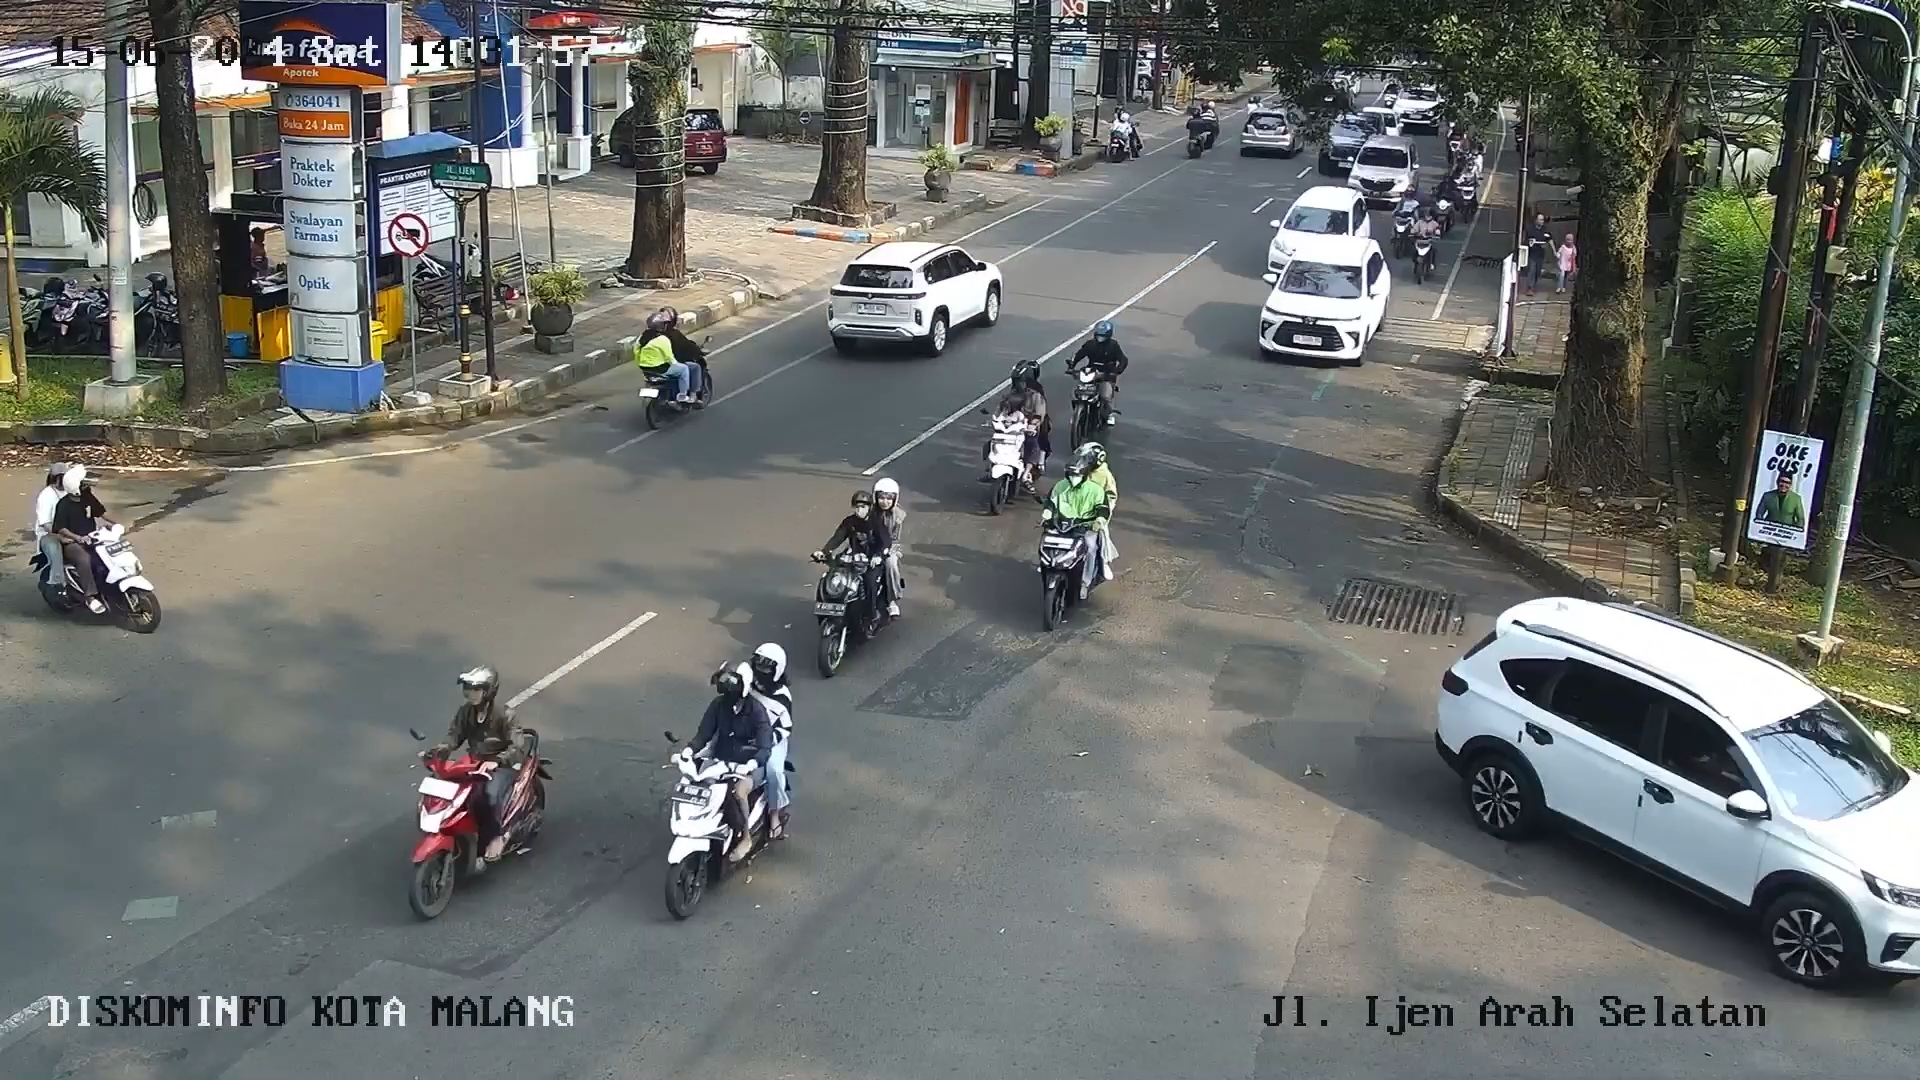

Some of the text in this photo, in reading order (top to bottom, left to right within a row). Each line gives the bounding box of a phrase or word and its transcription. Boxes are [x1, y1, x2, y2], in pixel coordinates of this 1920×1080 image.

[282, 67, 320, 79] Apotek
[295, 95, 341, 108] 364041
[283, 117, 345, 131] Buka 24 Jam
[290, 156, 335, 172] Praktek
[459, 166, 476, 175] IJEN
[292, 172, 333, 187] Dokter
[289, 210, 343, 229] Swalayan
[294, 226, 339, 242] Farmasi
[298, 274, 331, 292] Optik
[1775, 442, 1809, 461] OKE
[1766, 456, 1800, 475] GUS
